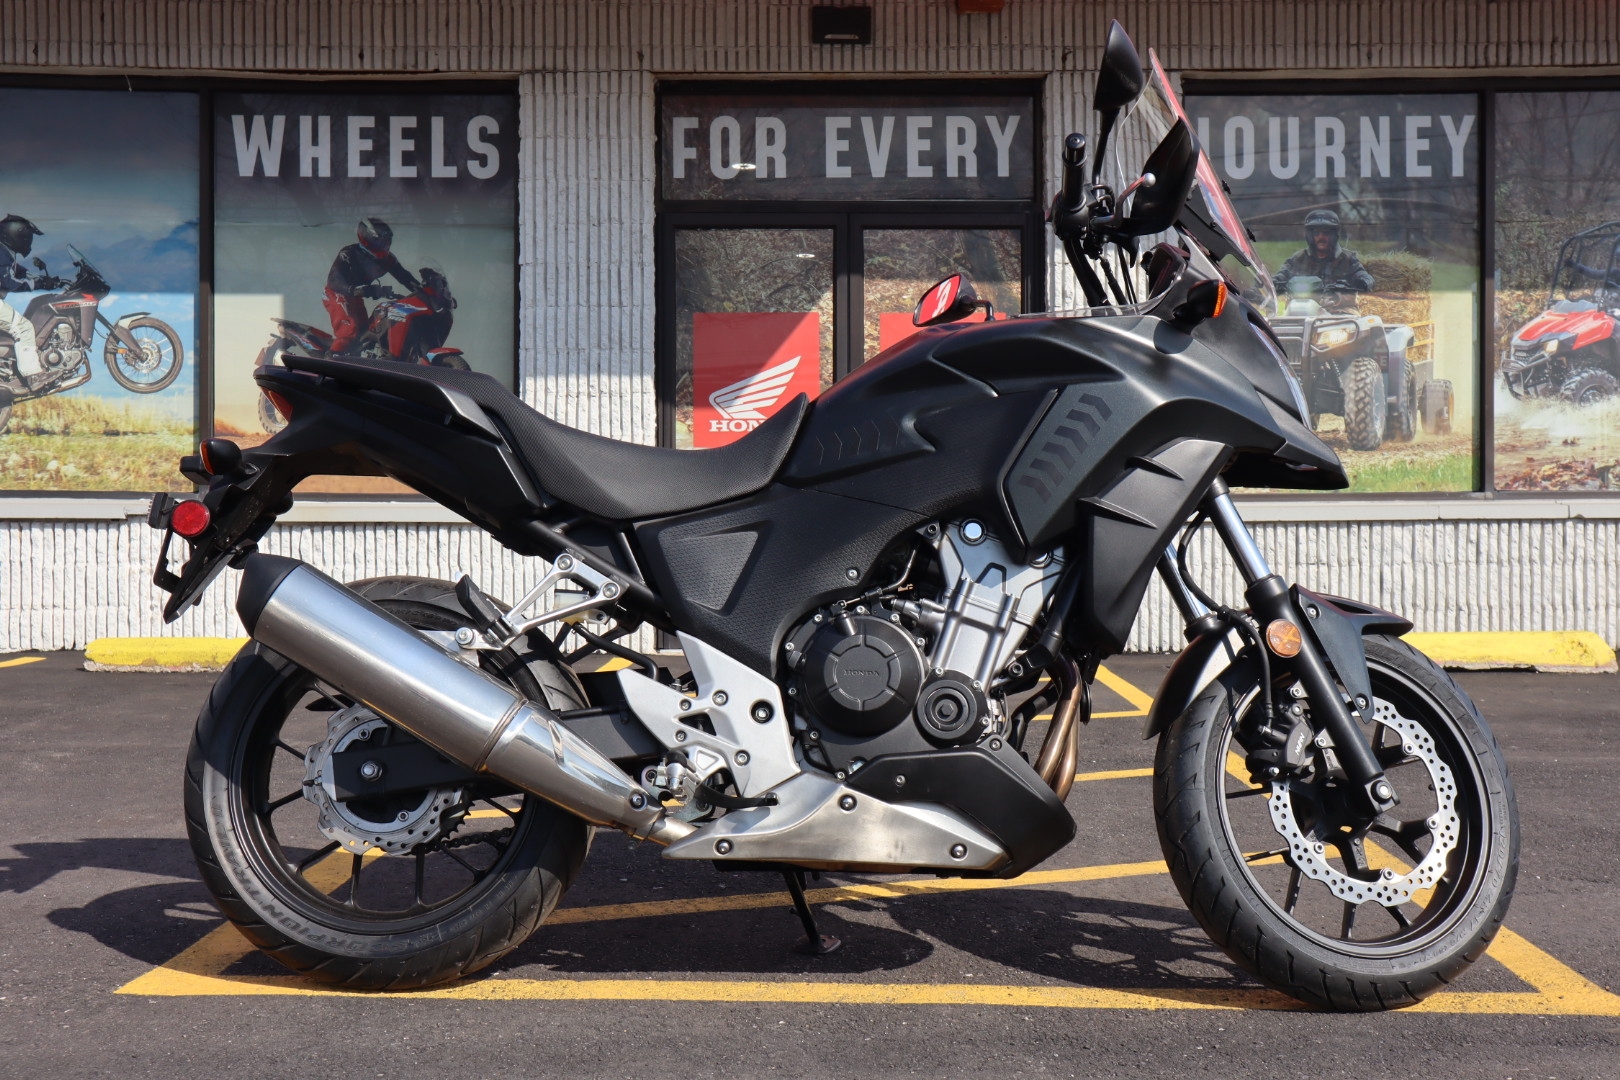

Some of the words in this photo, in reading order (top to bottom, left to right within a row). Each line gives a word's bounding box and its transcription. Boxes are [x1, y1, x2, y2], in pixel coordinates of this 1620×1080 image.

[231, 114, 500, 180] WHEELS
[672, 115, 787, 180] FOR
[825, 115, 1021, 178] EVERY
[709, 420, 768, 432] HON
[843, 669, 880, 677] HONDA
[262, 903, 398, 955] ORPION
